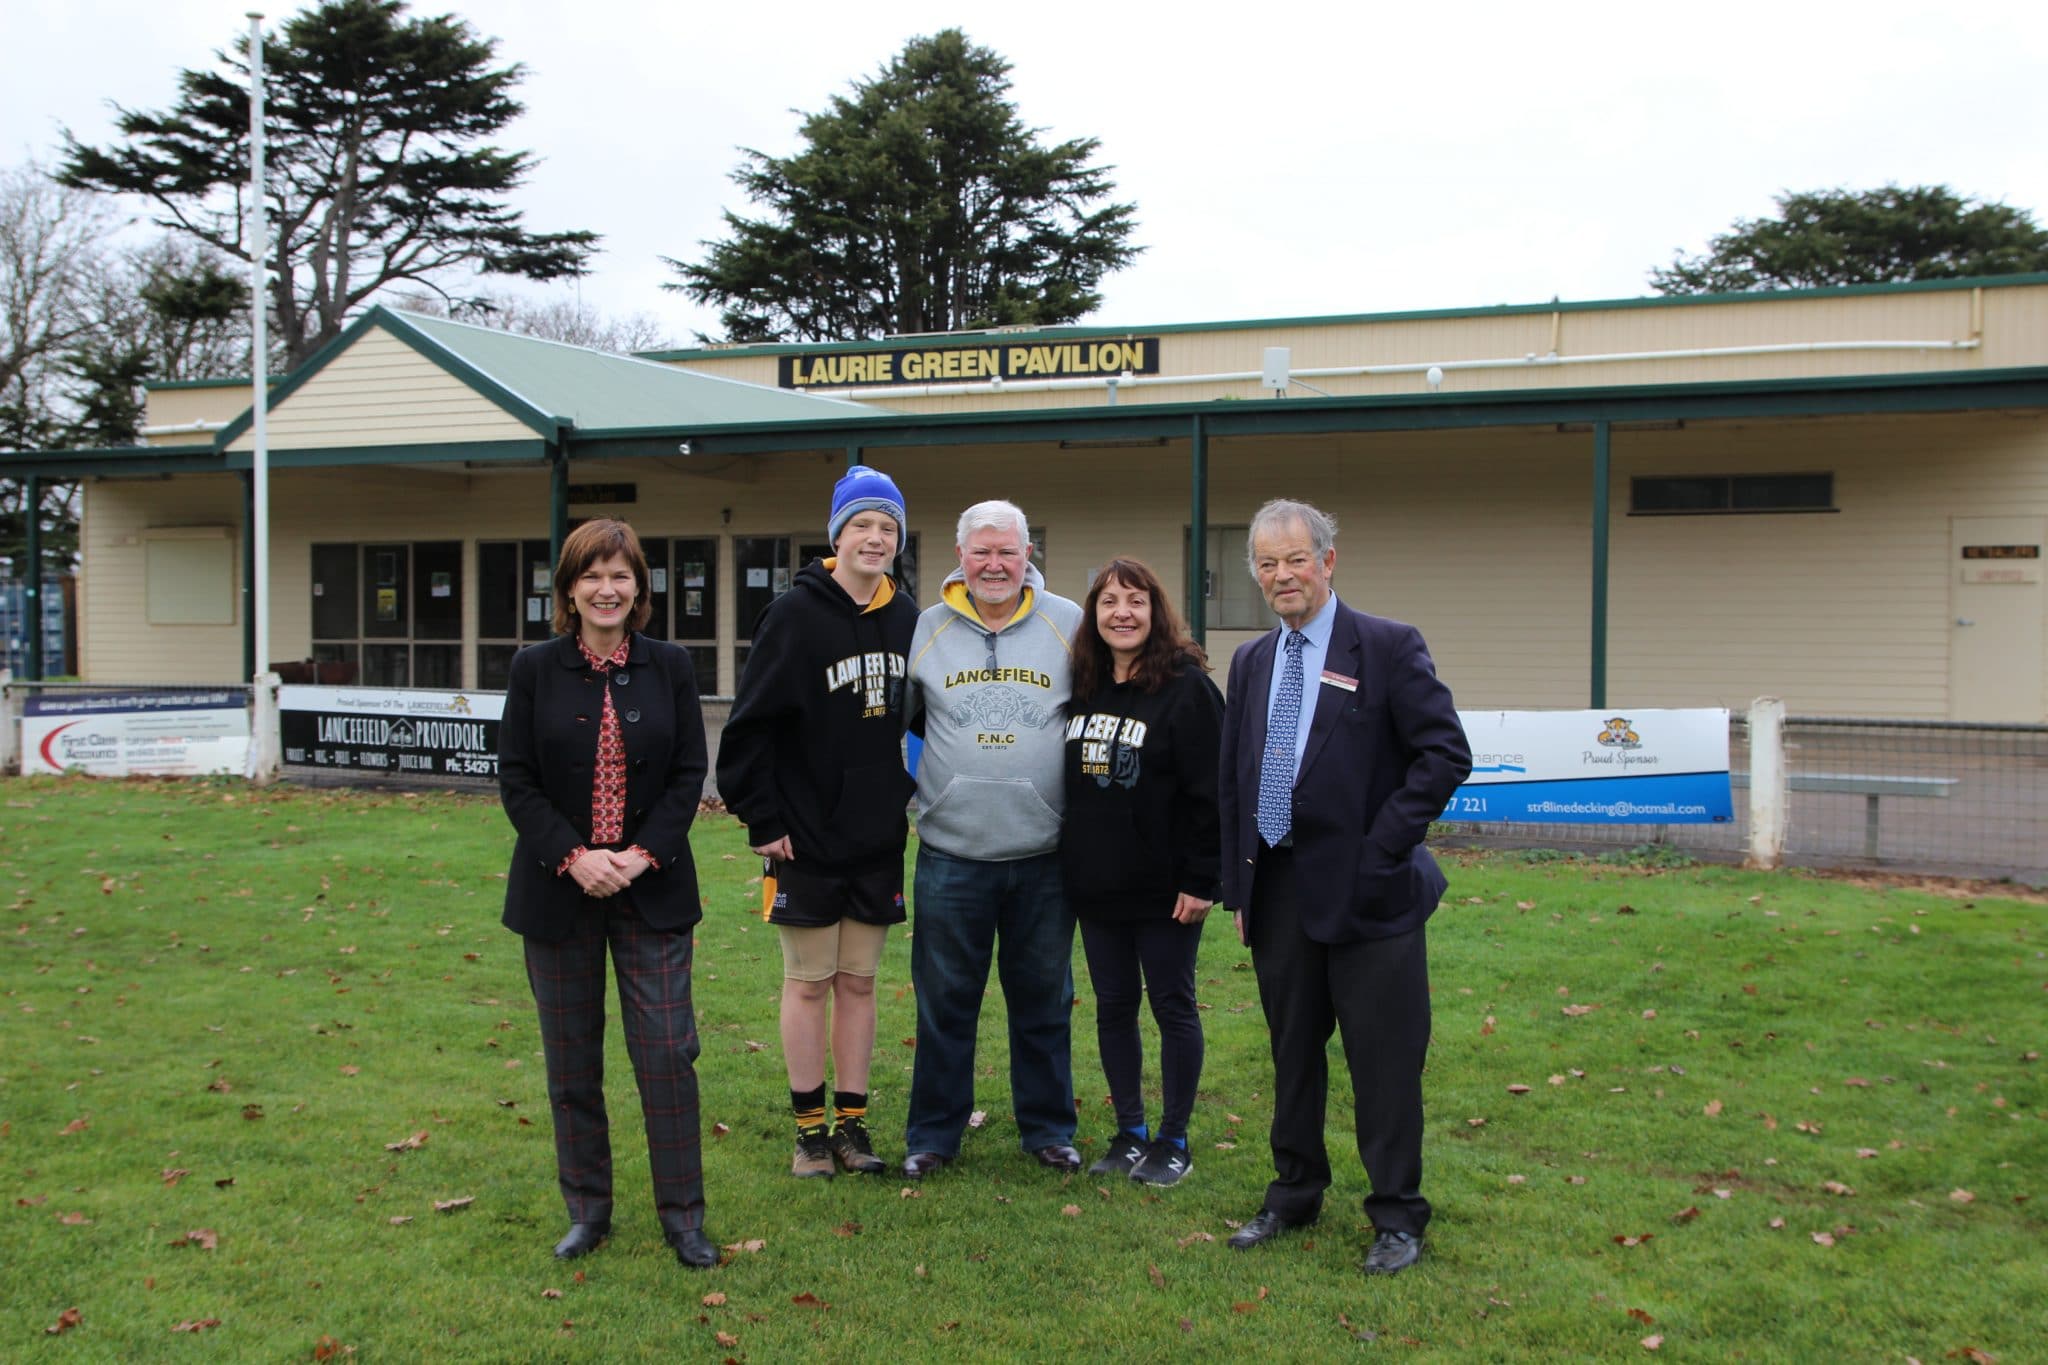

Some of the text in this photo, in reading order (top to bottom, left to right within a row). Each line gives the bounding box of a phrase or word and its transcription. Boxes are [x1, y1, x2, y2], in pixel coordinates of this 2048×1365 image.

[792, 342, 1144, 385] LAURIE GREEN PAVILION
[945, 668, 1051, 689] LANCEFIELD
[318, 716, 486, 750] LANCEFIELD PROVIDORE
[464, 760, 489, 774] 5429
[1583, 751, 1658, 770] Proud Sponsor
[1463, 797, 1487, 812] 221
[1527, 801, 1706, 817] str8linedecking@hotmail.com
